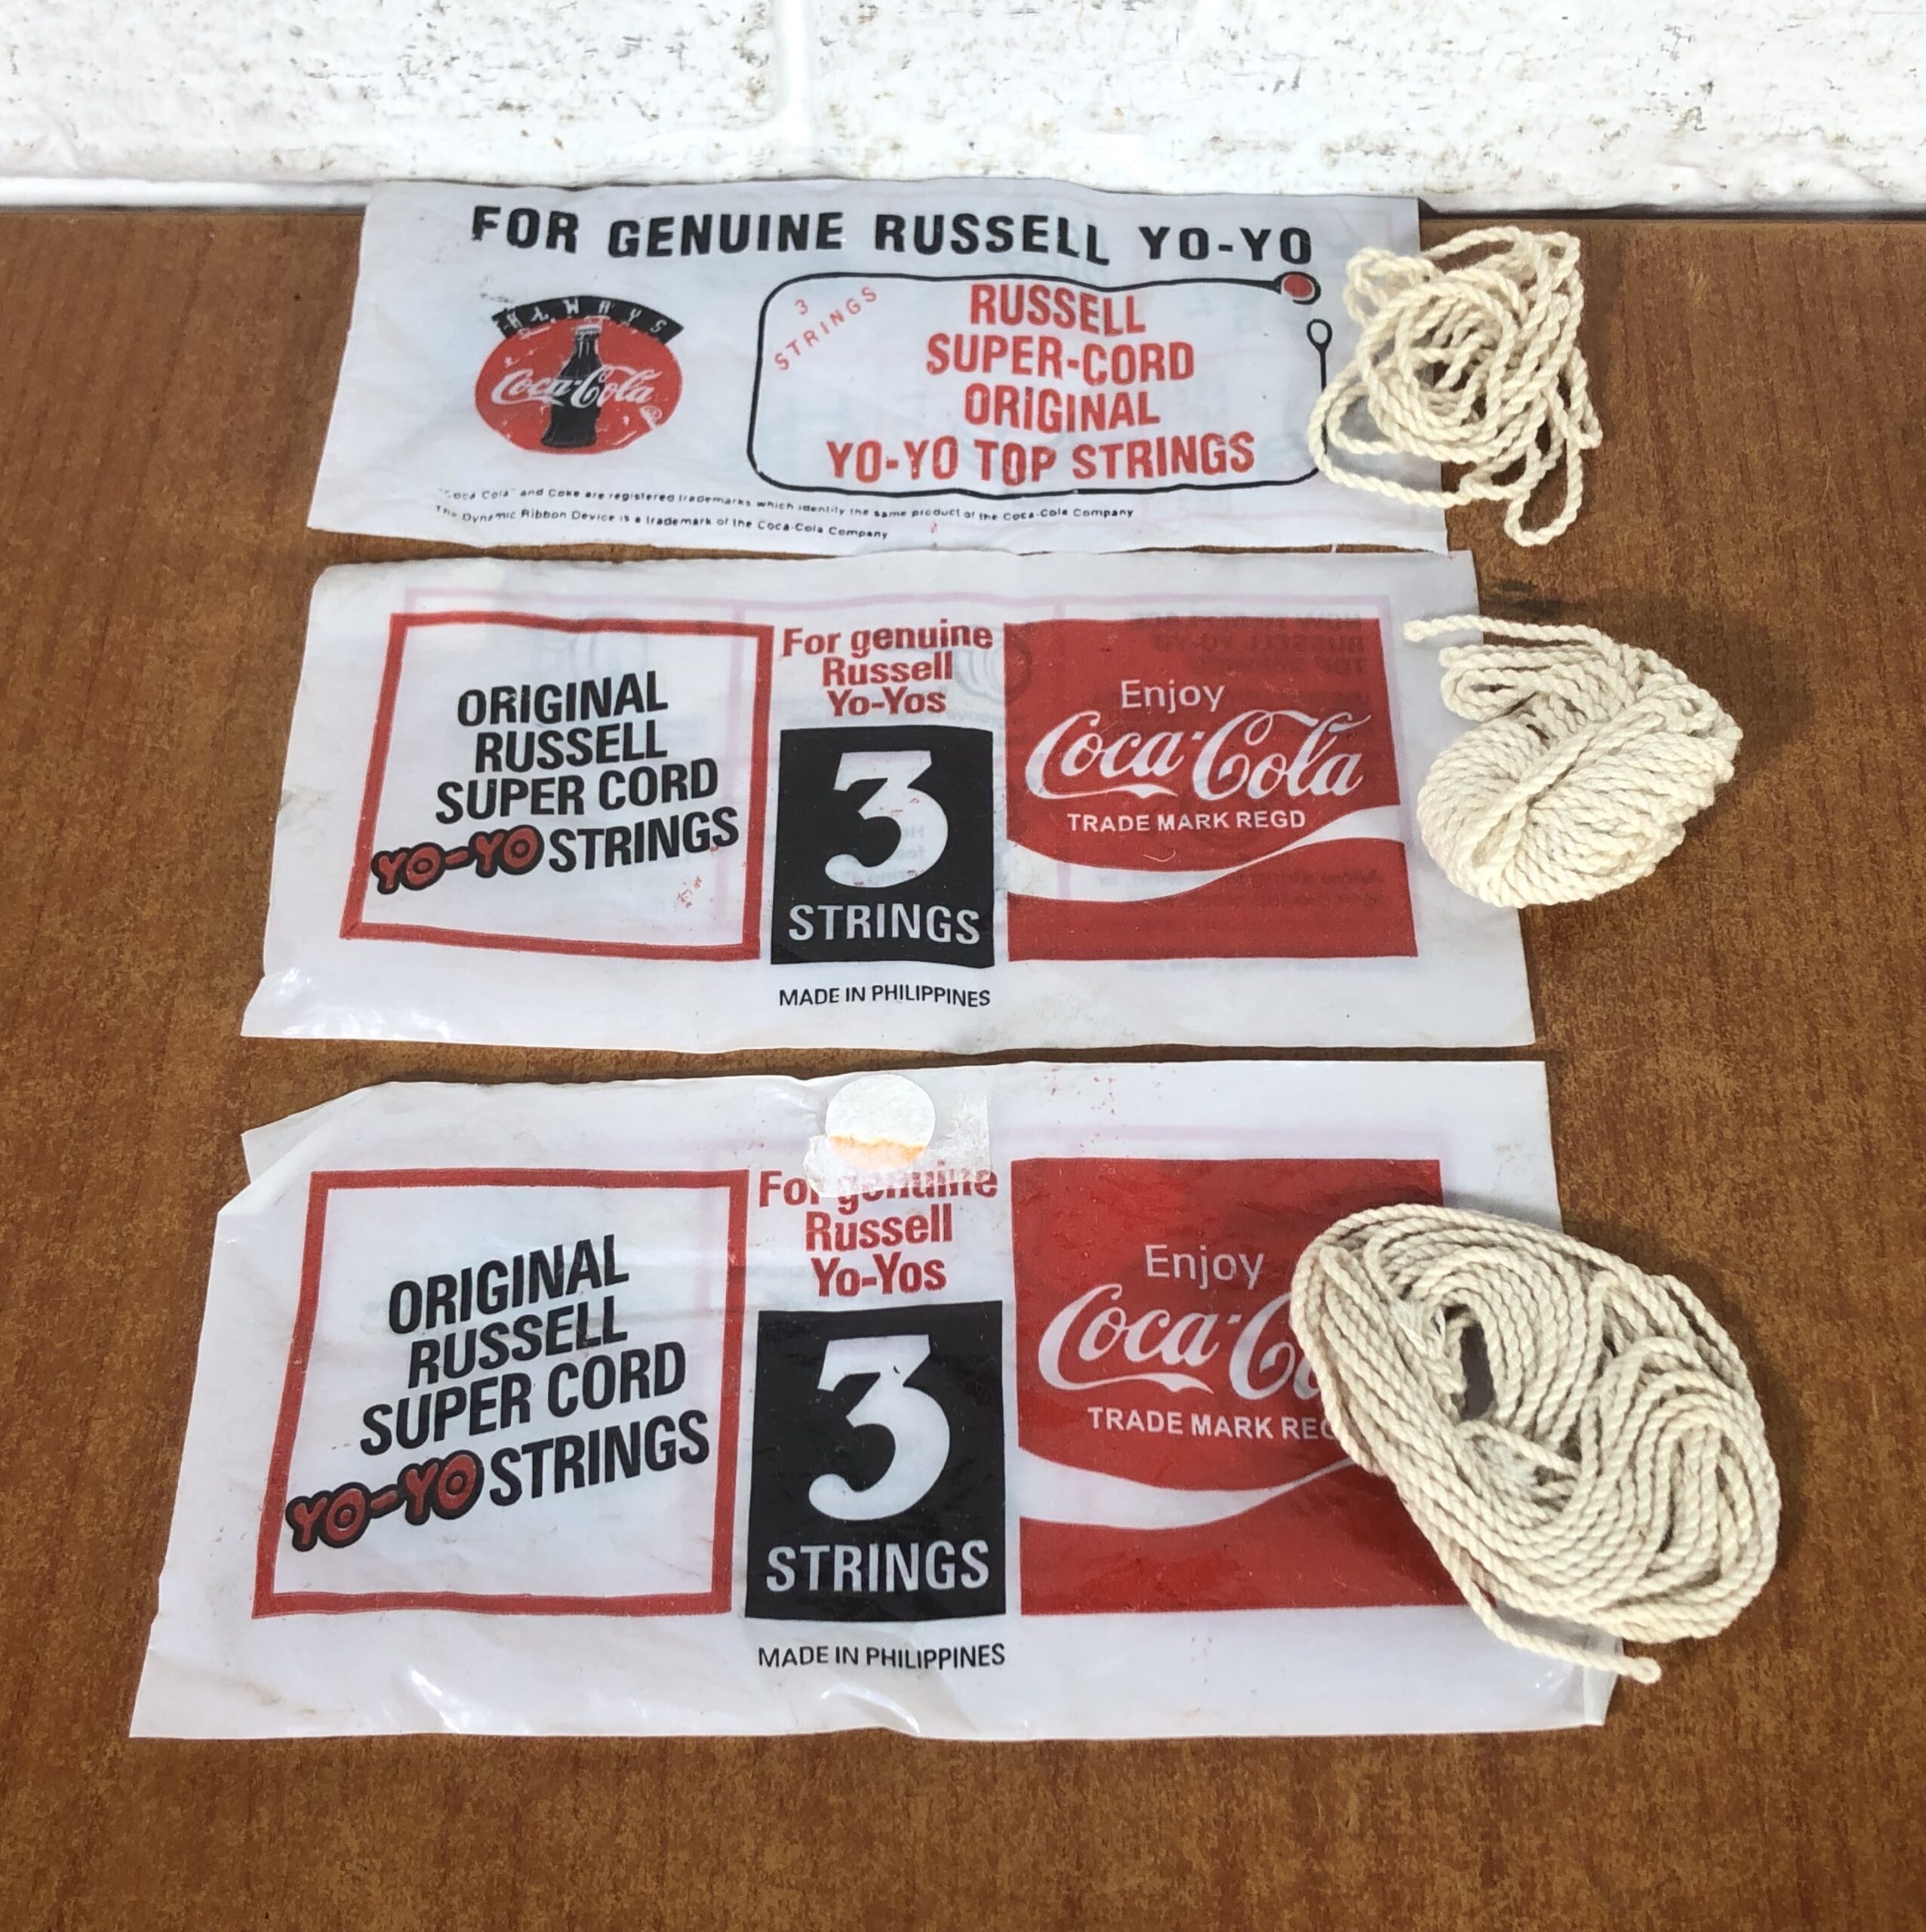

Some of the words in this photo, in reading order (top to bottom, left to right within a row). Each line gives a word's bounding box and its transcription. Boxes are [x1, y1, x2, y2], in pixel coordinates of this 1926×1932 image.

[472, 205, 579, 254] FOR
[608, 211, 843, 258] GENUINE
[875, 213, 1109, 265] RUSSELL
[1138, 226, 1312, 265] YO-YO
[774, 286, 878, 371] STRINGS
[795, 298, 809, 315] 3
[970, 284, 1146, 336] RUSSELL
[491, 362, 663, 408] Coca-Cola
[927, 334, 1195, 385] SUPER-CORD
[965, 381, 1160, 434] ORIGINAL
[826, 435, 958, 483] YO-YO
[974, 439, 1056, 486] TOP
[1072, 431, 1254, 479] STRINGS
[520, 488, 544, 497] and
[548, 488, 580, 497] Coke
[585, 491, 605, 500] are
[609, 492, 675, 503] registered
[678, 494, 751, 507] trademarks
[756, 501, 794, 510] which
[798, 505, 845, 515] identify
[873, 510, 906, 518] same
[911, 509, 960, 518] product
[979, 512, 998, 521] the
[1073, 508, 1134, 519] Company
[521, 509, 567, 519] Ribbon
[571, 510, 615, 521] Device
[646, 516, 712, 526] trademark
[716, 518, 729, 526] of
[733, 518, 752, 528] the
[828, 526, 888, 540] Company
[783, 628, 840, 657] For
[851, 618, 992, 660] genuine
[823, 650, 952, 687] Russell
[457, 670, 669, 727] ORIGINAL
[827, 686, 946, 716] Yo-Yos
[1121, 679, 1225, 714] Enjoy
[475, 720, 668, 774] RUSSELL
[1024, 709, 1372, 801] Coca-Cola
[435, 774, 585, 824] SUPER
[598, 757, 718, 810] CORD
[825, 750, 948, 888] 3
[1066, 813, 1150, 832] TRADE
[1157, 811, 1229, 832] MARK
[1236, 810, 1306, 829] REGD
[371, 823, 545, 894] YO-YO
[549, 806, 740, 872] STRINGS
[789, 903, 980, 944] STRINGS
[779, 987, 840, 1007] MADE
[845, 986, 866, 1003] IN
[872, 983, 991, 1008] PHILIPPINES
[805, 1201, 952, 1252] Russell
[389, 1234, 629, 1334] ORIGINAL
[811, 1247, 946, 1297] Yo-Yos
[1145, 1244, 1263, 1289] Enjoy
[408, 1295, 628, 1389] RUSSELL
[360, 1372, 531, 1456] SUPER
[547, 1340, 686, 1418] CORD
[1087, 1406, 1183, 1435] TRADE
[1191, 1413, 1274, 1439] MARK
[808, 1334, 950, 1521] 3
[285, 1450, 485, 1552] YO-YO
[489, 1408, 709, 1506] STRINGS
[766, 1540, 989, 1592] STRINGS
[758, 1645, 829, 1669] MADE
[835, 1645, 860, 1666] IN
[866, 1642, 1006, 1671] PHILIPPINES
